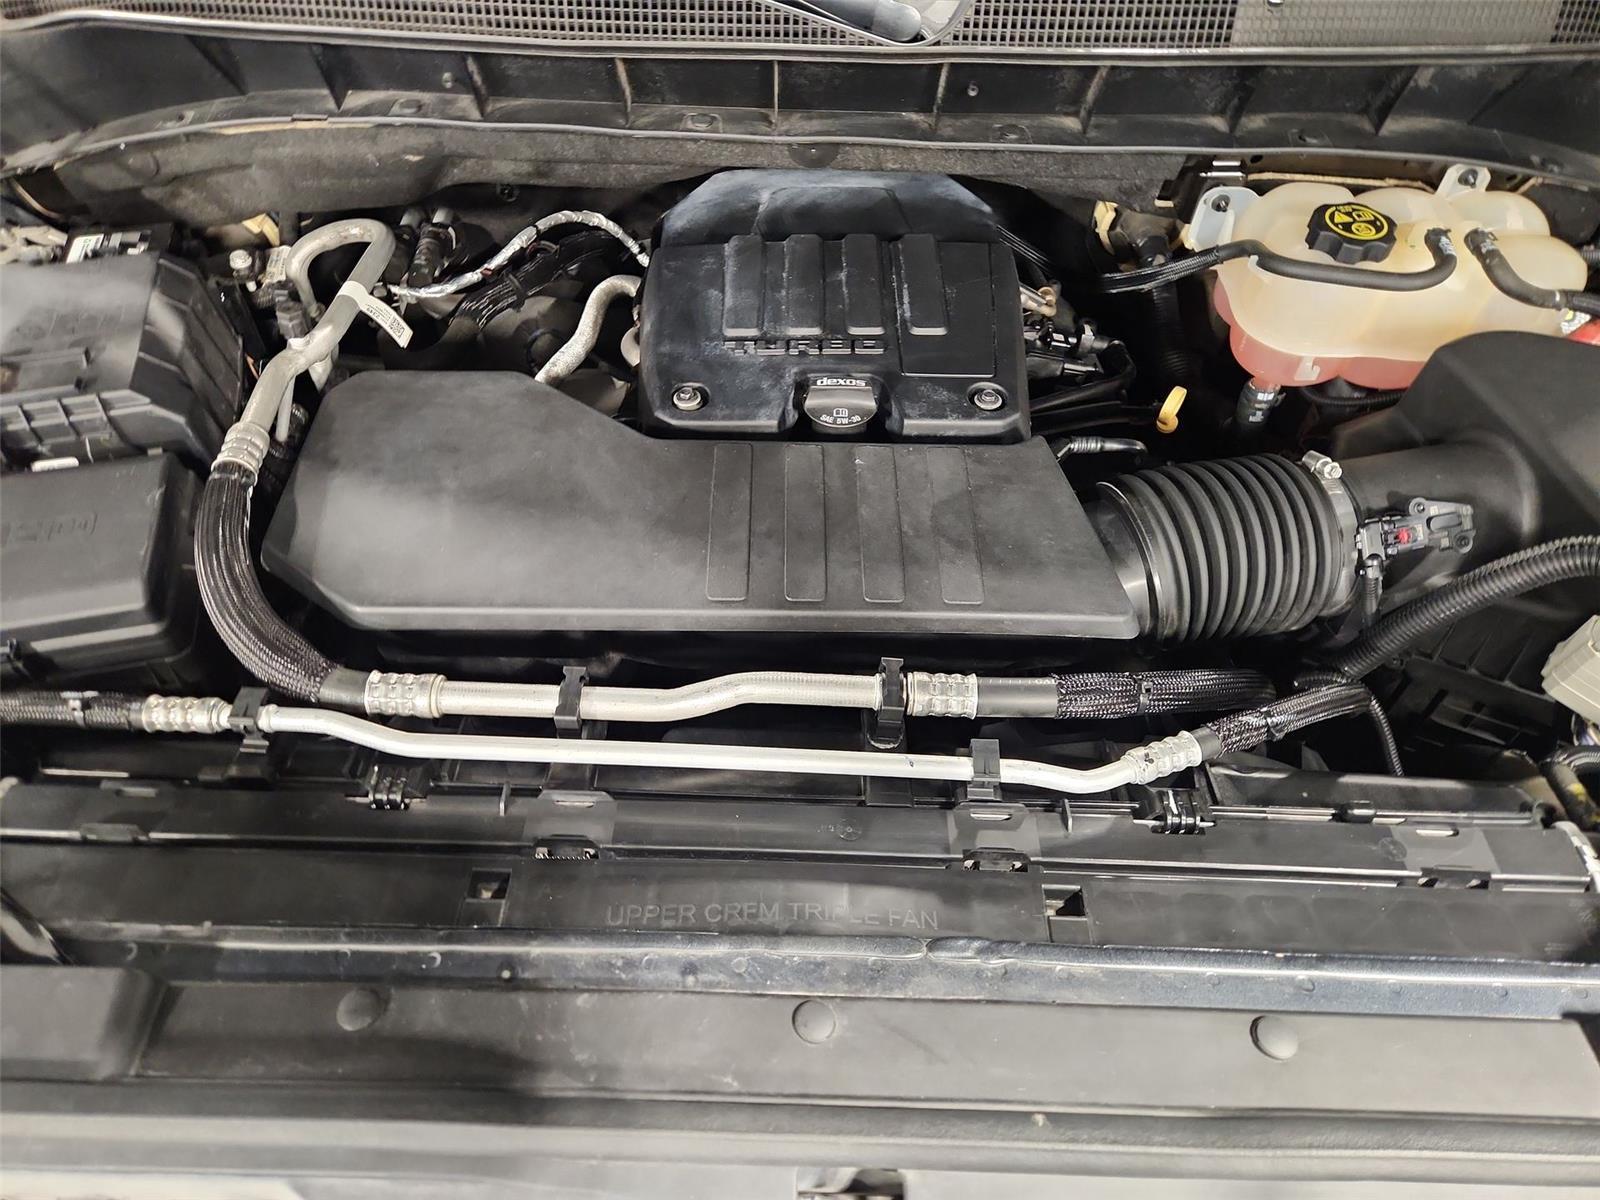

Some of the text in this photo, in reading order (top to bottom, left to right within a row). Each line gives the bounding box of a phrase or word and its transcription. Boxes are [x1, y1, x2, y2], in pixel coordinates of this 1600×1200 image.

[816, 377, 866, 386] dexos
[820, 414, 861, 425] SAE 5W-30
[606, 903, 697, 925] UPPER
[888, 908, 939, 930] FAN
